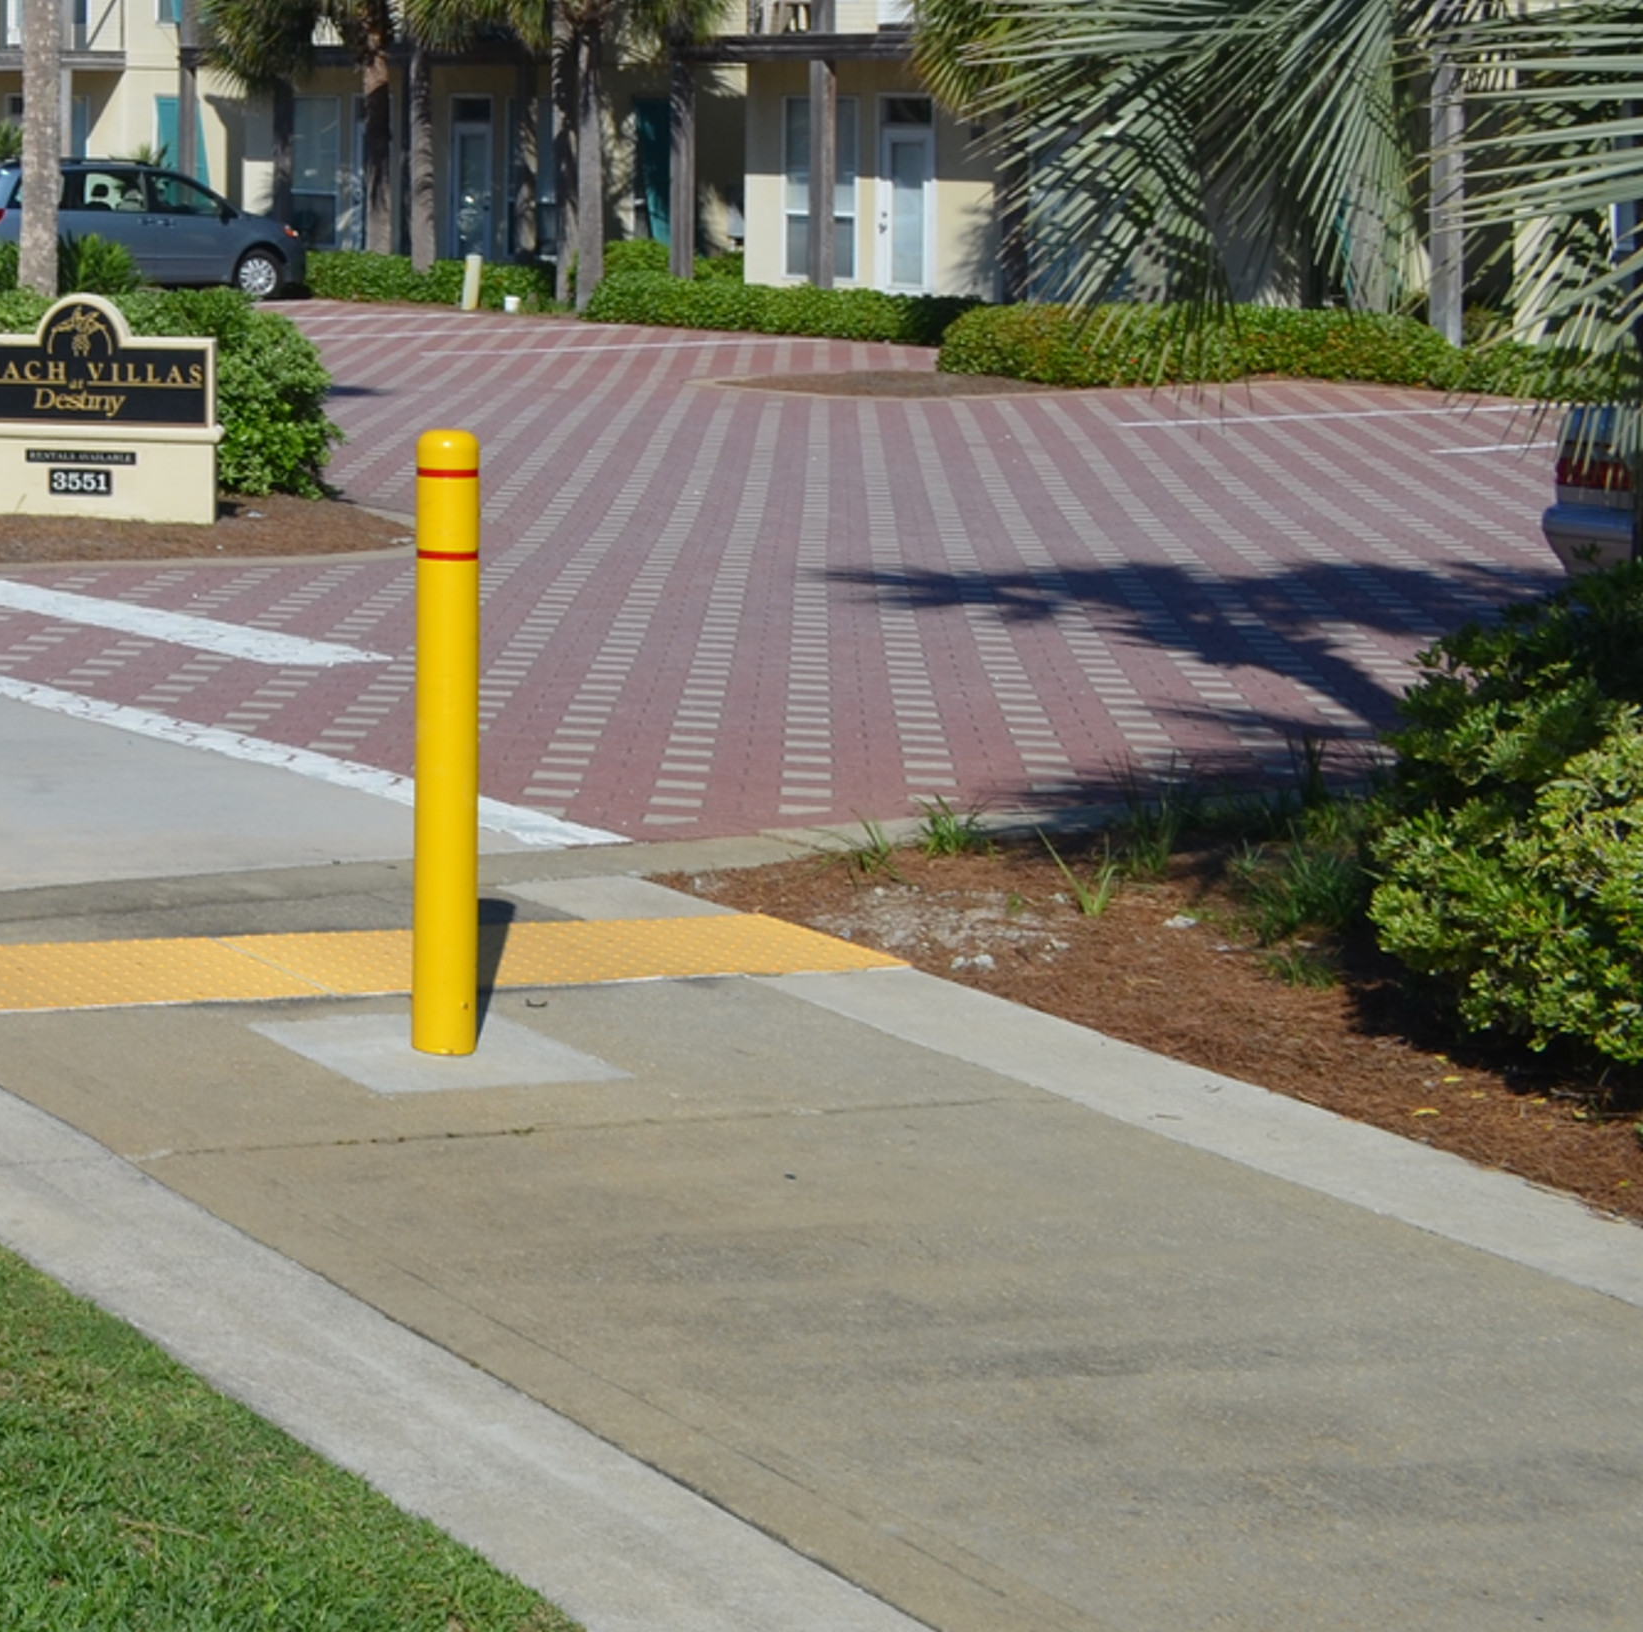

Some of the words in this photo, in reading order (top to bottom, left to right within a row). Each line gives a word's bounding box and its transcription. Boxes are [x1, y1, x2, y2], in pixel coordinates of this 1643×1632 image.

[87, 362, 203, 384] VILLAS
[68, 378, 85, 390] at
[33, 387, 126, 416] Destiny
[29, 451, 76, 461] RENTALS
[78, 452, 132, 463] AVAILABLE
[52, 471, 107, 491] 3551
